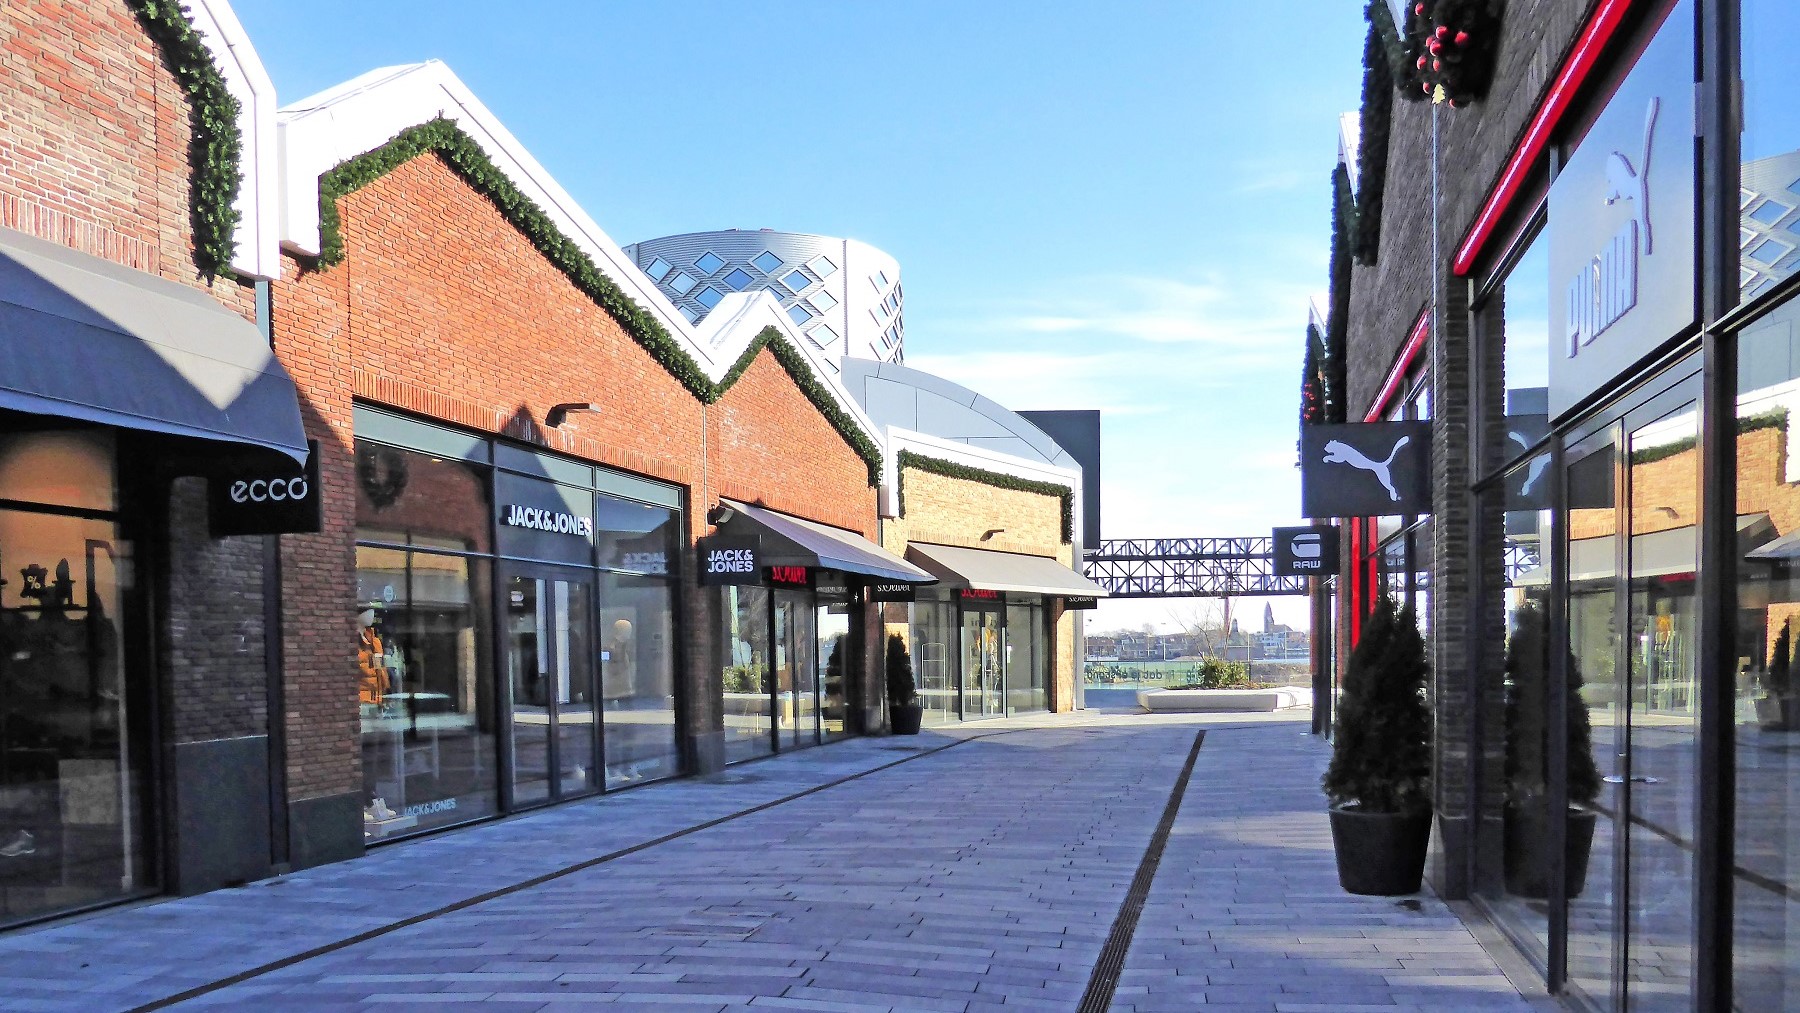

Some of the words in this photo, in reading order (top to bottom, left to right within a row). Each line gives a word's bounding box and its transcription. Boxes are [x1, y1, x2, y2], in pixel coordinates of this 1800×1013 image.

[1565, 219, 1638, 359] PUMA
[230, 477, 308, 503] ecco
[507, 503, 593, 537] JACK&JONES
[707, 549, 754, 561] JACK&
[1292, 560, 1321, 569] RAW
[707, 561, 754, 573] JONES
